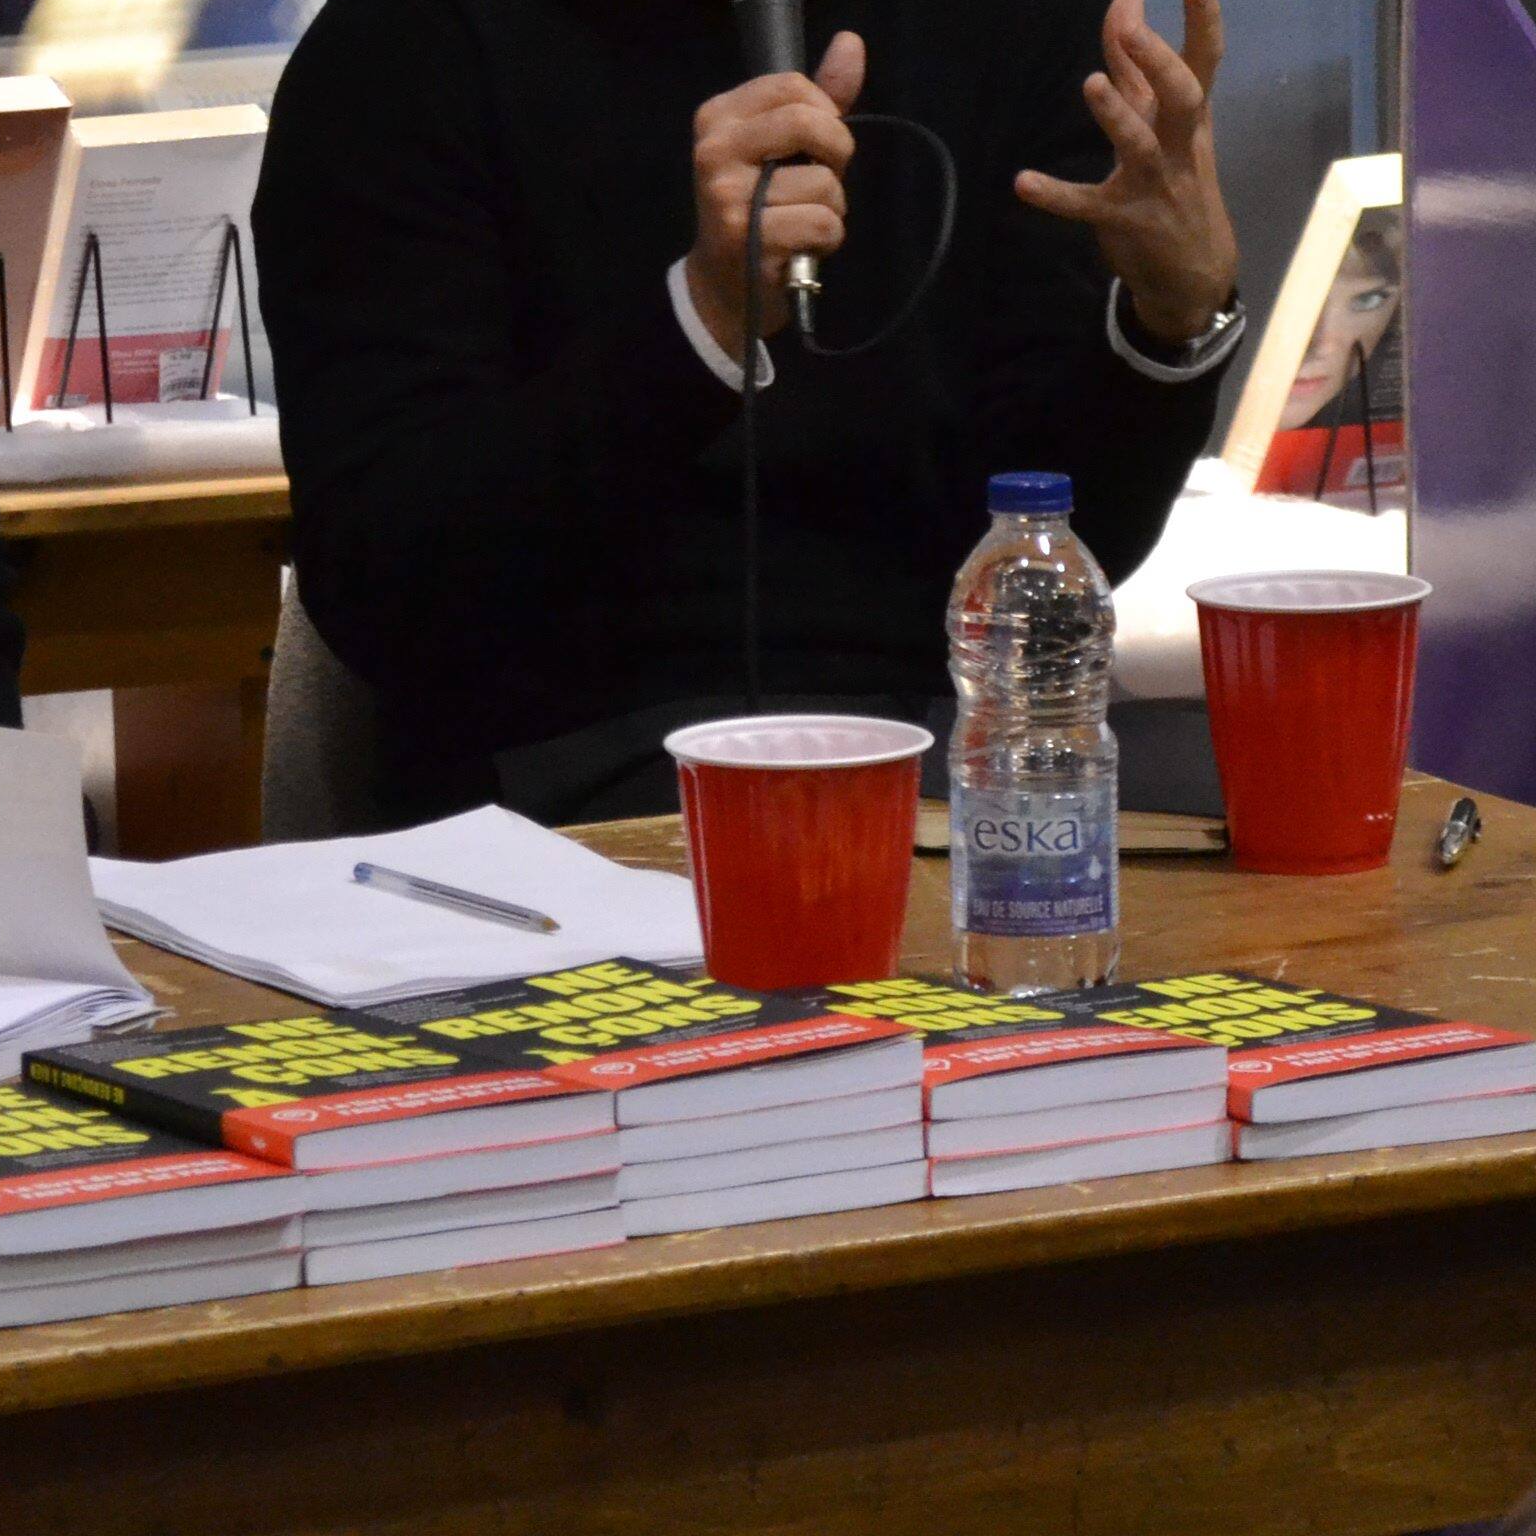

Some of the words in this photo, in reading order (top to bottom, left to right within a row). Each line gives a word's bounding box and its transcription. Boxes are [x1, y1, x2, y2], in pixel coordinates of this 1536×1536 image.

[974, 819, 1080, 853] eska
[525, 961, 654, 995] NE
[825, 976, 954, 1000] NE
[1136, 972, 1262, 999] NE
[419, 977, 717, 1041] RENON-
[538, 992, 763, 1047] ÇONS
[825, 991, 1021, 1020] NON-
[896, 1003, 1066, 1032] ONS
[1094, 987, 1325, 1031] ENON-
[225, 1014, 359, 1042] NE
[111, 1030, 418, 1079] RENON-
[230, 1047, 461, 1086] ÇONS
